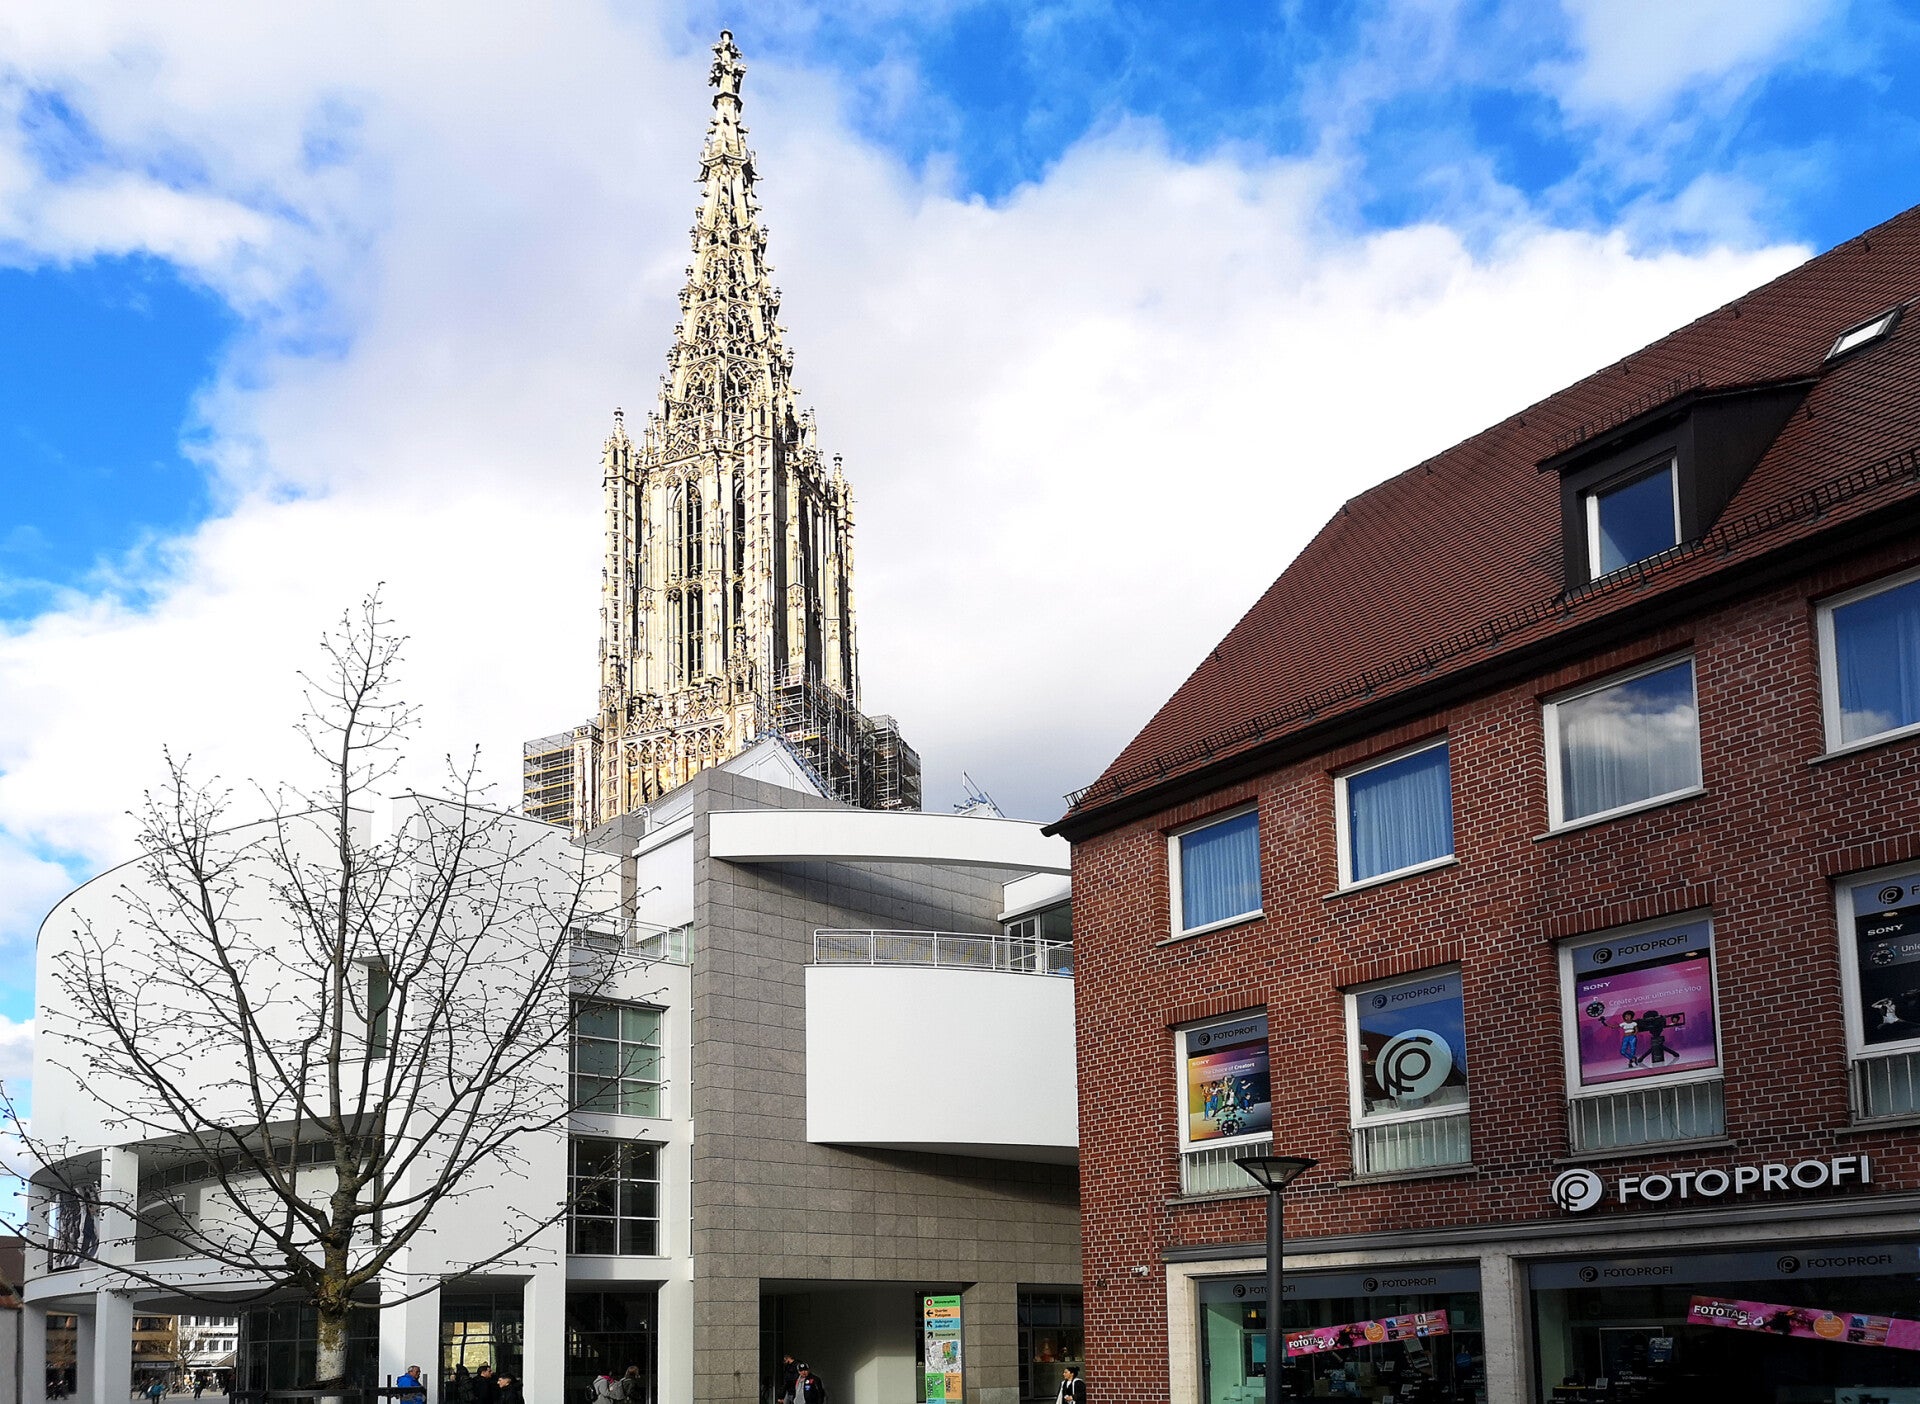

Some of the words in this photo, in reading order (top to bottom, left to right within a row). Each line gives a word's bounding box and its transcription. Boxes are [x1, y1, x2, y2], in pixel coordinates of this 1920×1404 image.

[1867, 923, 1904, 936] SONY
[1618, 934, 1688, 957] FOTOPROFI
[1583, 981, 1611, 991] SONY
[1391, 984, 1446, 1003] FOTOPROFI
[1608, 998, 1631, 1006] Create
[1632, 994, 1652, 1003] your
[1652, 988, 1683, 999] ultimate
[1213, 1025, 1258, 1041] FOTOPROFI
[1192, 1059, 1210, 1067] SONY
[1234, 1062, 1255, 1070] Creators
[1618, 1155, 1870, 1203] FOTOPROFI
[1806, 1254, 1892, 1269] FOTOPROFI
[1603, 1266, 1673, 1278] FOTOPROFI
[1382, 1277, 1436, 1288] FOTOPROFI
[1694, 1305, 1754, 1320] FOTOTAGE
[1737, 1316, 1764, 1326] 2.0
[1289, 1336, 1328, 1348] FOTOTAGE
[1318, 1337, 1335, 1349] 2.0
